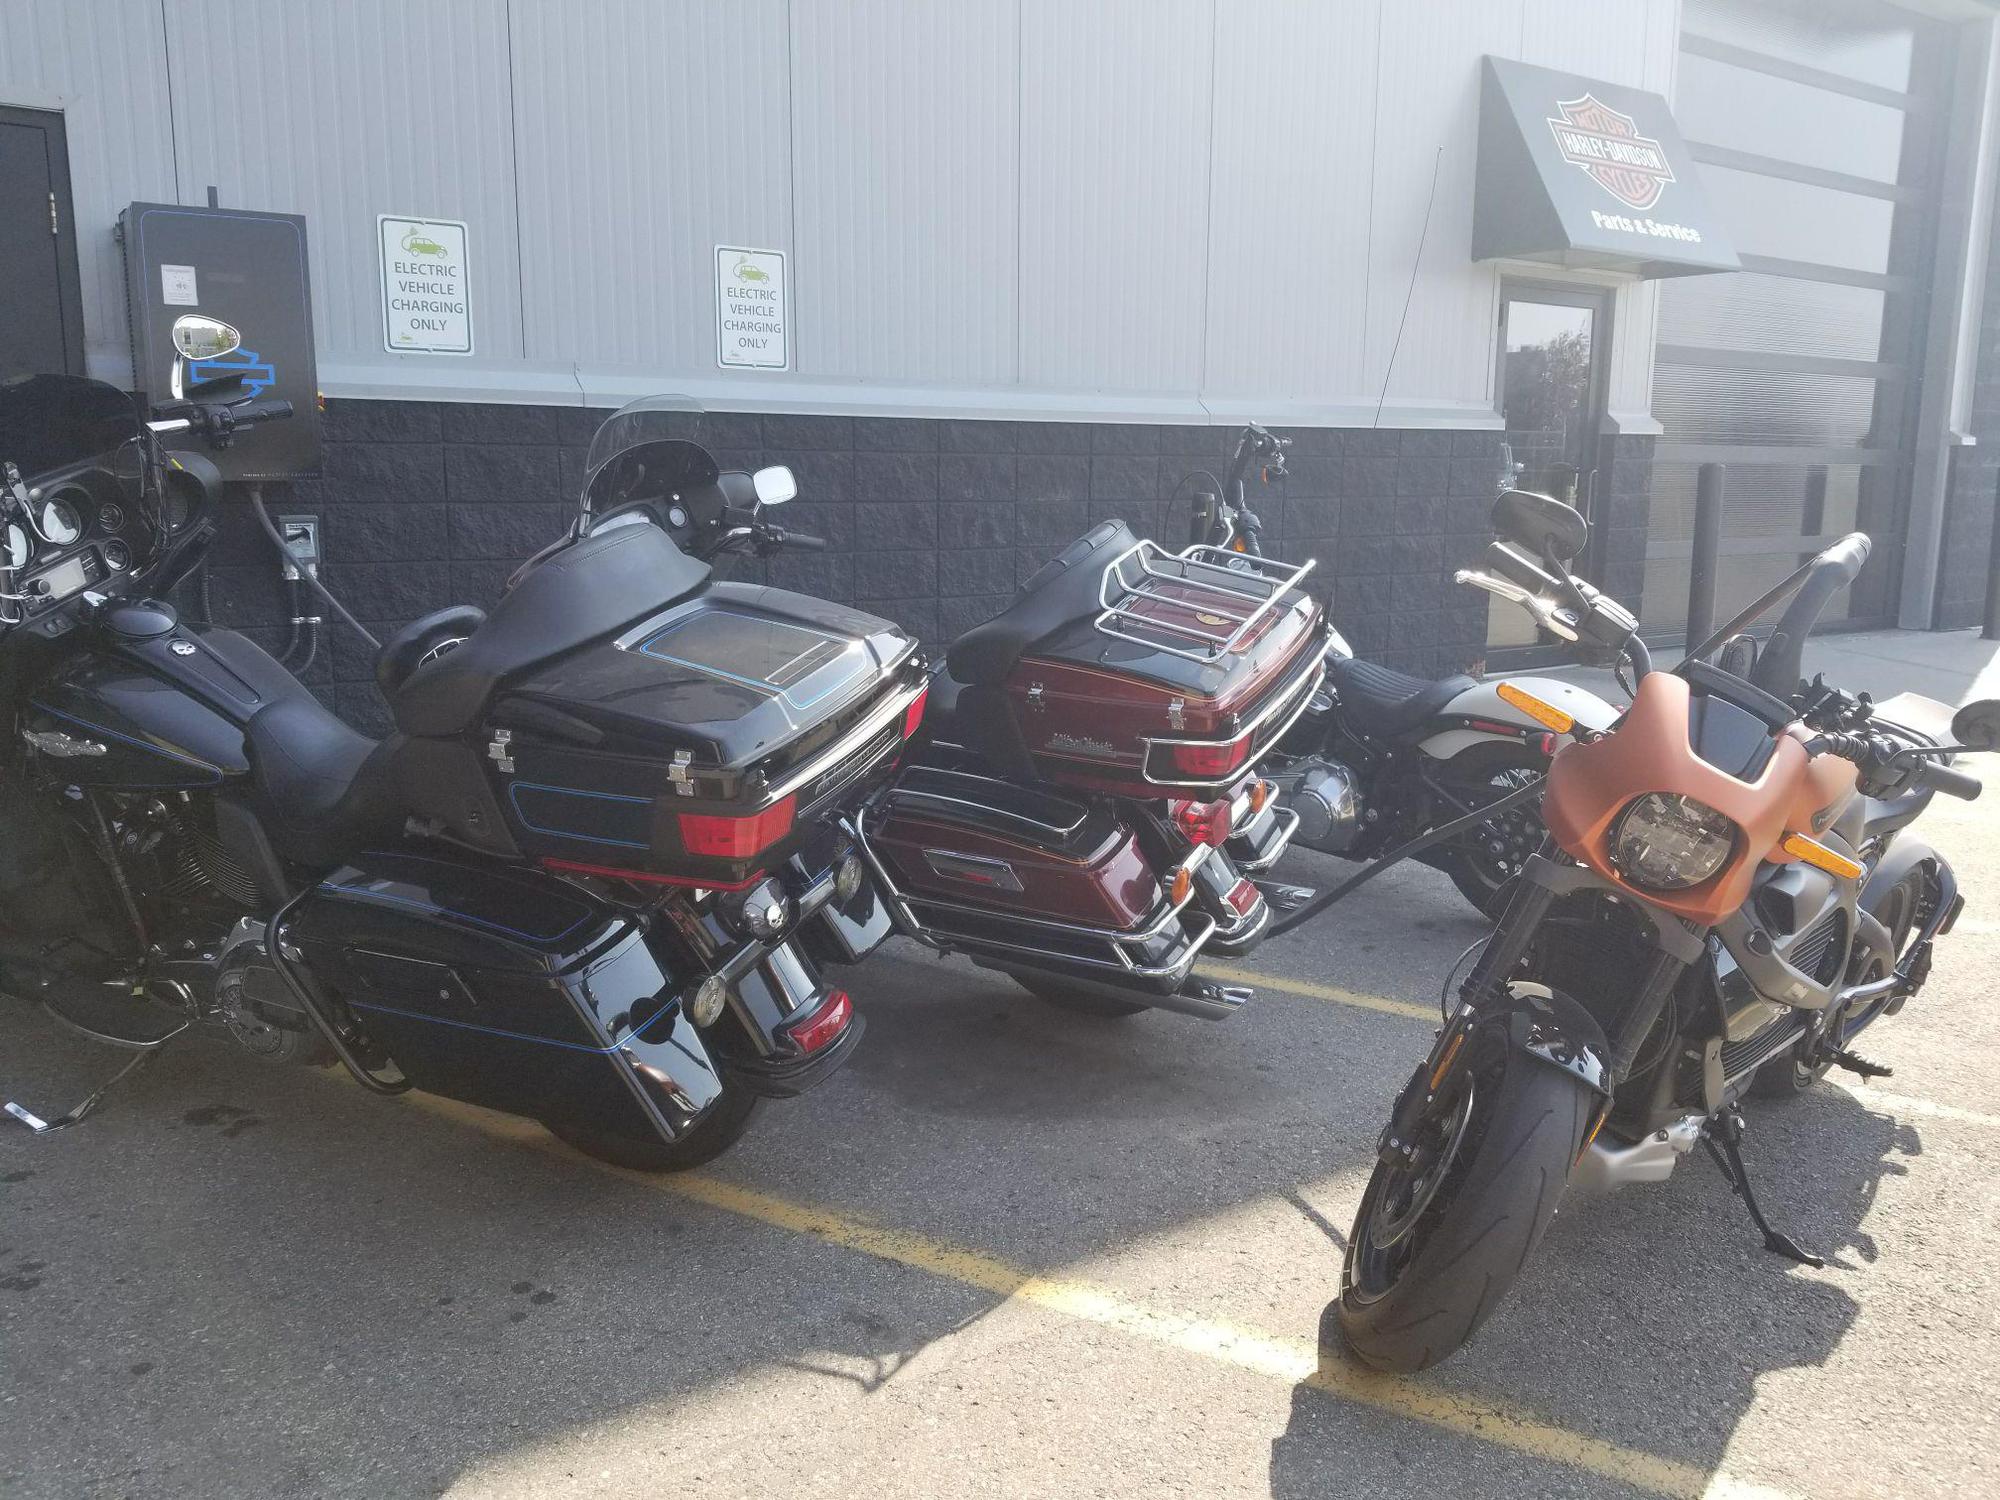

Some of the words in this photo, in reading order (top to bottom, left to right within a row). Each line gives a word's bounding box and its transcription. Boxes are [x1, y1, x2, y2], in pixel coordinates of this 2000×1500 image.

[1561, 131, 1663, 169] HARLEY-DAVIDSON
[1591, 210, 1634, 232] Parts
[1633, 219, 1648, 234] &
[1645, 218, 1701, 242] Service
[394, 261, 457, 277] ELECTRIC
[399, 280, 455, 295] VEHICLE
[727, 287, 777, 301] ELECTRIC
[391, 299, 464, 314] CHARGING
[730, 304, 775, 317] VEHICLE
[410, 318, 448, 331] ONLY
[723, 320, 782, 333] CHARGING
[738, 337, 768, 348] ONLY
